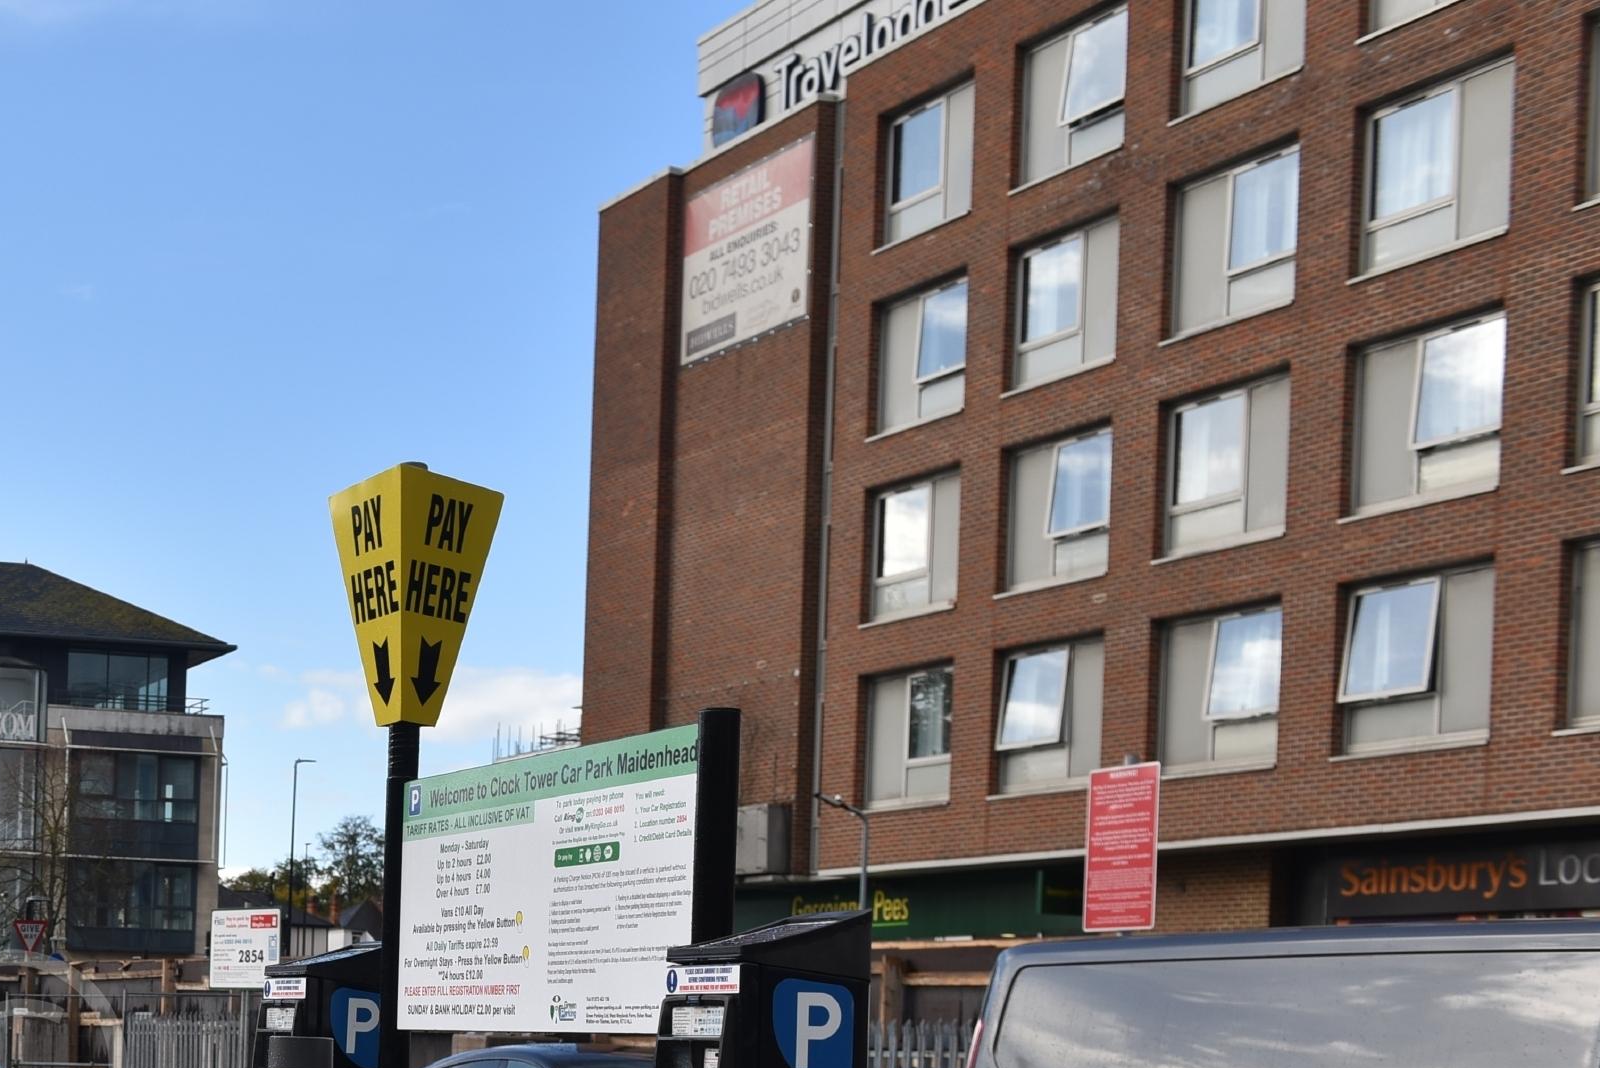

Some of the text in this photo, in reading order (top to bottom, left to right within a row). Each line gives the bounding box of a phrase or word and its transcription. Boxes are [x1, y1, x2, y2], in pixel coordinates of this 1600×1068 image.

[720, 168, 771, 210] RETAIL
[709, 185, 783, 241] PREMISES
[689, 227, 800, 300] 020 7493 3043
[709, 248, 725, 262] ALL
[351, 495, 382, 556] PAY
[424, 494, 473, 553] PAY
[351, 560, 399, 624] HERE
[405, 560, 472, 623] HERE
[412, 742, 697, 811] P Welcome to Clock Tower Car Park Maidenhead
[407, 823, 427, 837] TARIFF
[429, 819, 449, 834] RATES
[454, 816, 466, 830] ALL
[468, 810, 503, 828] INCLUSIVE
[505, 808, 514, 822] OF
[515, 806, 530, 821] VAT
[440, 841, 460, 856] Monday
[465, 837, 489, 852] Saturday
[437, 853, 491, 872] Up to 2 hours £2.00
[437, 868, 491, 886] Up to 4 hours £4.00
[1340, 855, 1528, 899] Sainsbury's
[436, 883, 490, 898] Over 4 hours £7.00
[441, 907, 453, 918] Vans
[473, 905, 484, 918] Day
[873, 890, 909, 921] Pees
[413, 917, 515, 935] Available by pressing the Yellow Button
[434, 941, 447, 953] Daily
[448, 940, 464, 951] Tariffs
[466, 939, 482, 951] expire
[483, 938, 498, 949] 23:59
[239, 950, 264, 963] 2854
[404, 959, 412, 968] For
[414, 957, 437, 970] Overnight
[439, 957, 453, 969] Stays
[458, 956, 473, 966] Press
[474, 955, 482, 965] the
[484, 954, 502, 965] Yellow
[503, 953, 522, 964] Button
[449, 970, 464, 981] hours
[465, 970, 483, 980] £12.00
[404, 985, 520, 997] PLEASE ENTER FULL REGISTRATION NUMBER FIRST
[408, 1004, 516, 1017] SUNDAY & BANK HOLIDAY £2.00 per visit
[345, 997, 380, 1054] P
